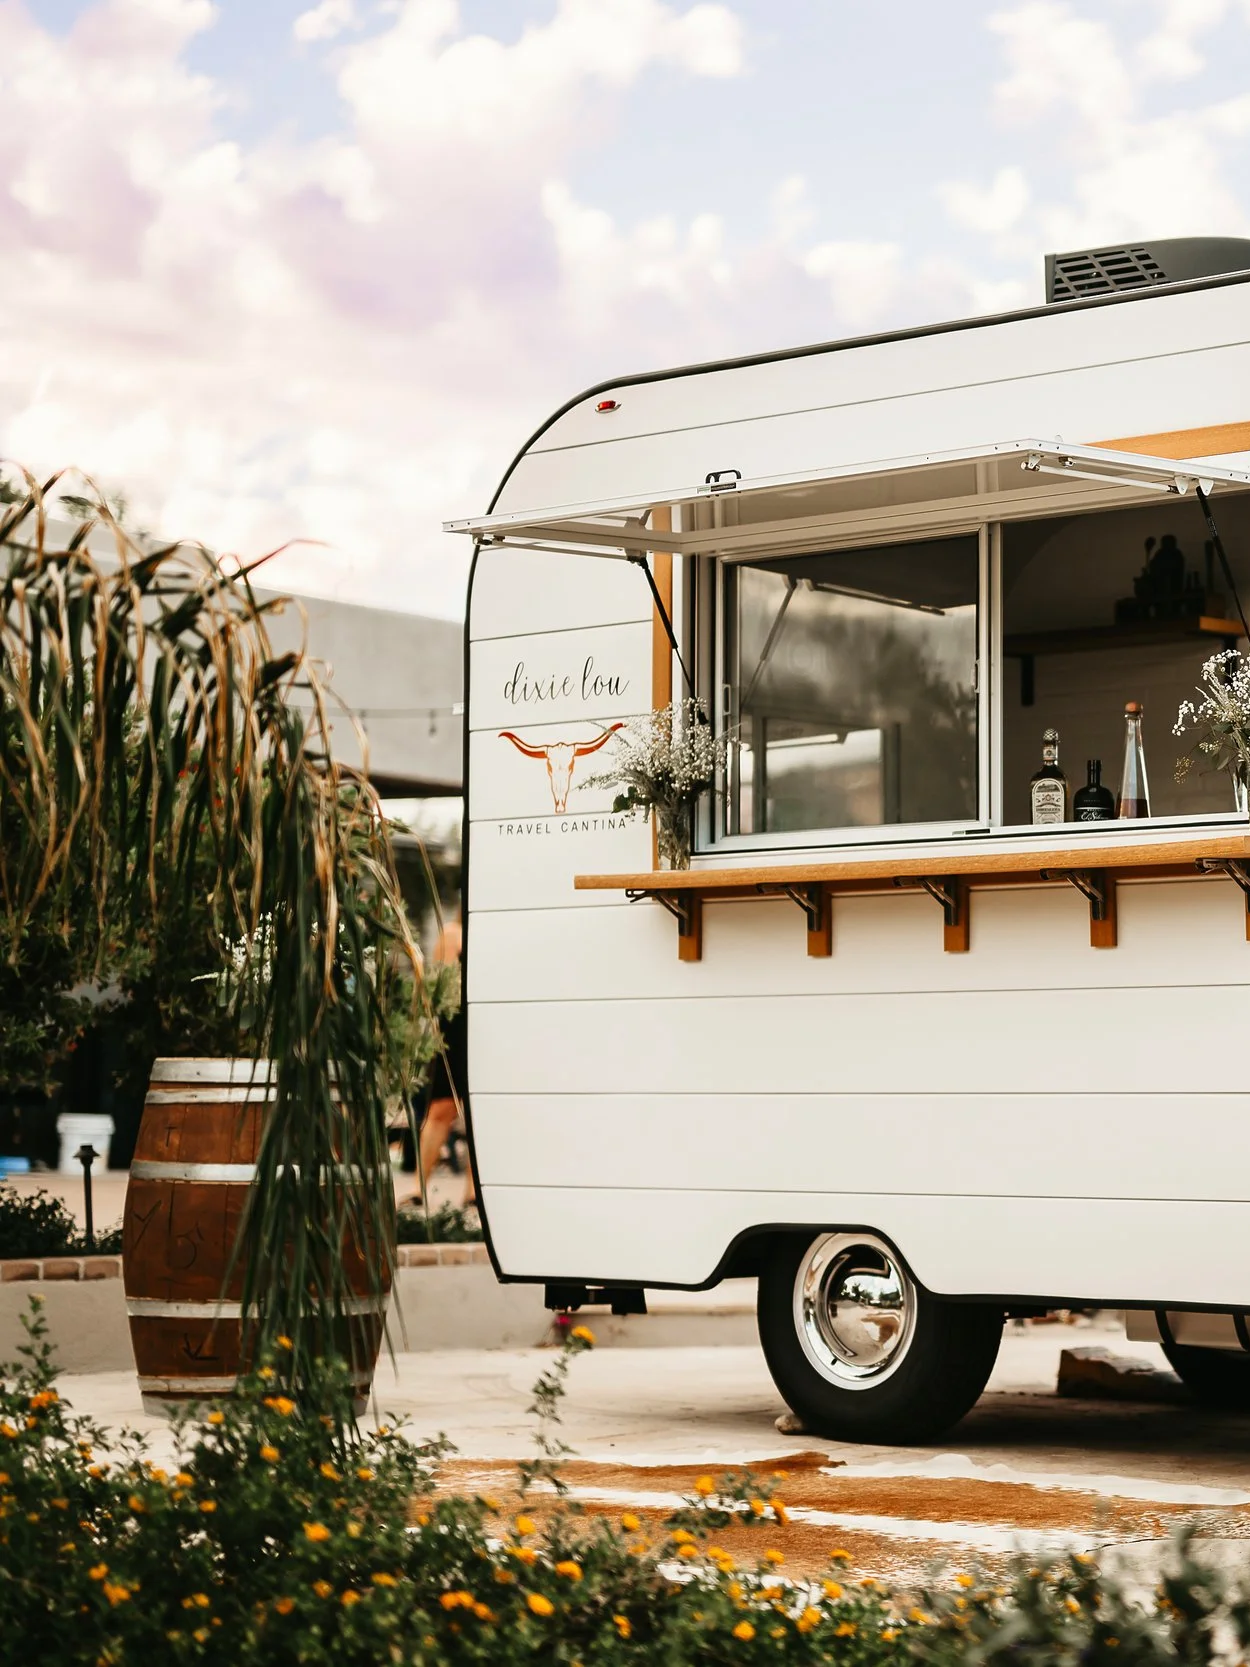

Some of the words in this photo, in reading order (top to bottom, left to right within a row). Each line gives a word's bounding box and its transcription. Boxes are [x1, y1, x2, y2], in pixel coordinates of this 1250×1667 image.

[504, 661, 575, 704] dixie
[581, 656, 630, 700] lou
[498, 822, 552, 836] TRAVEL
[560, 817, 627, 833] CANTINA
